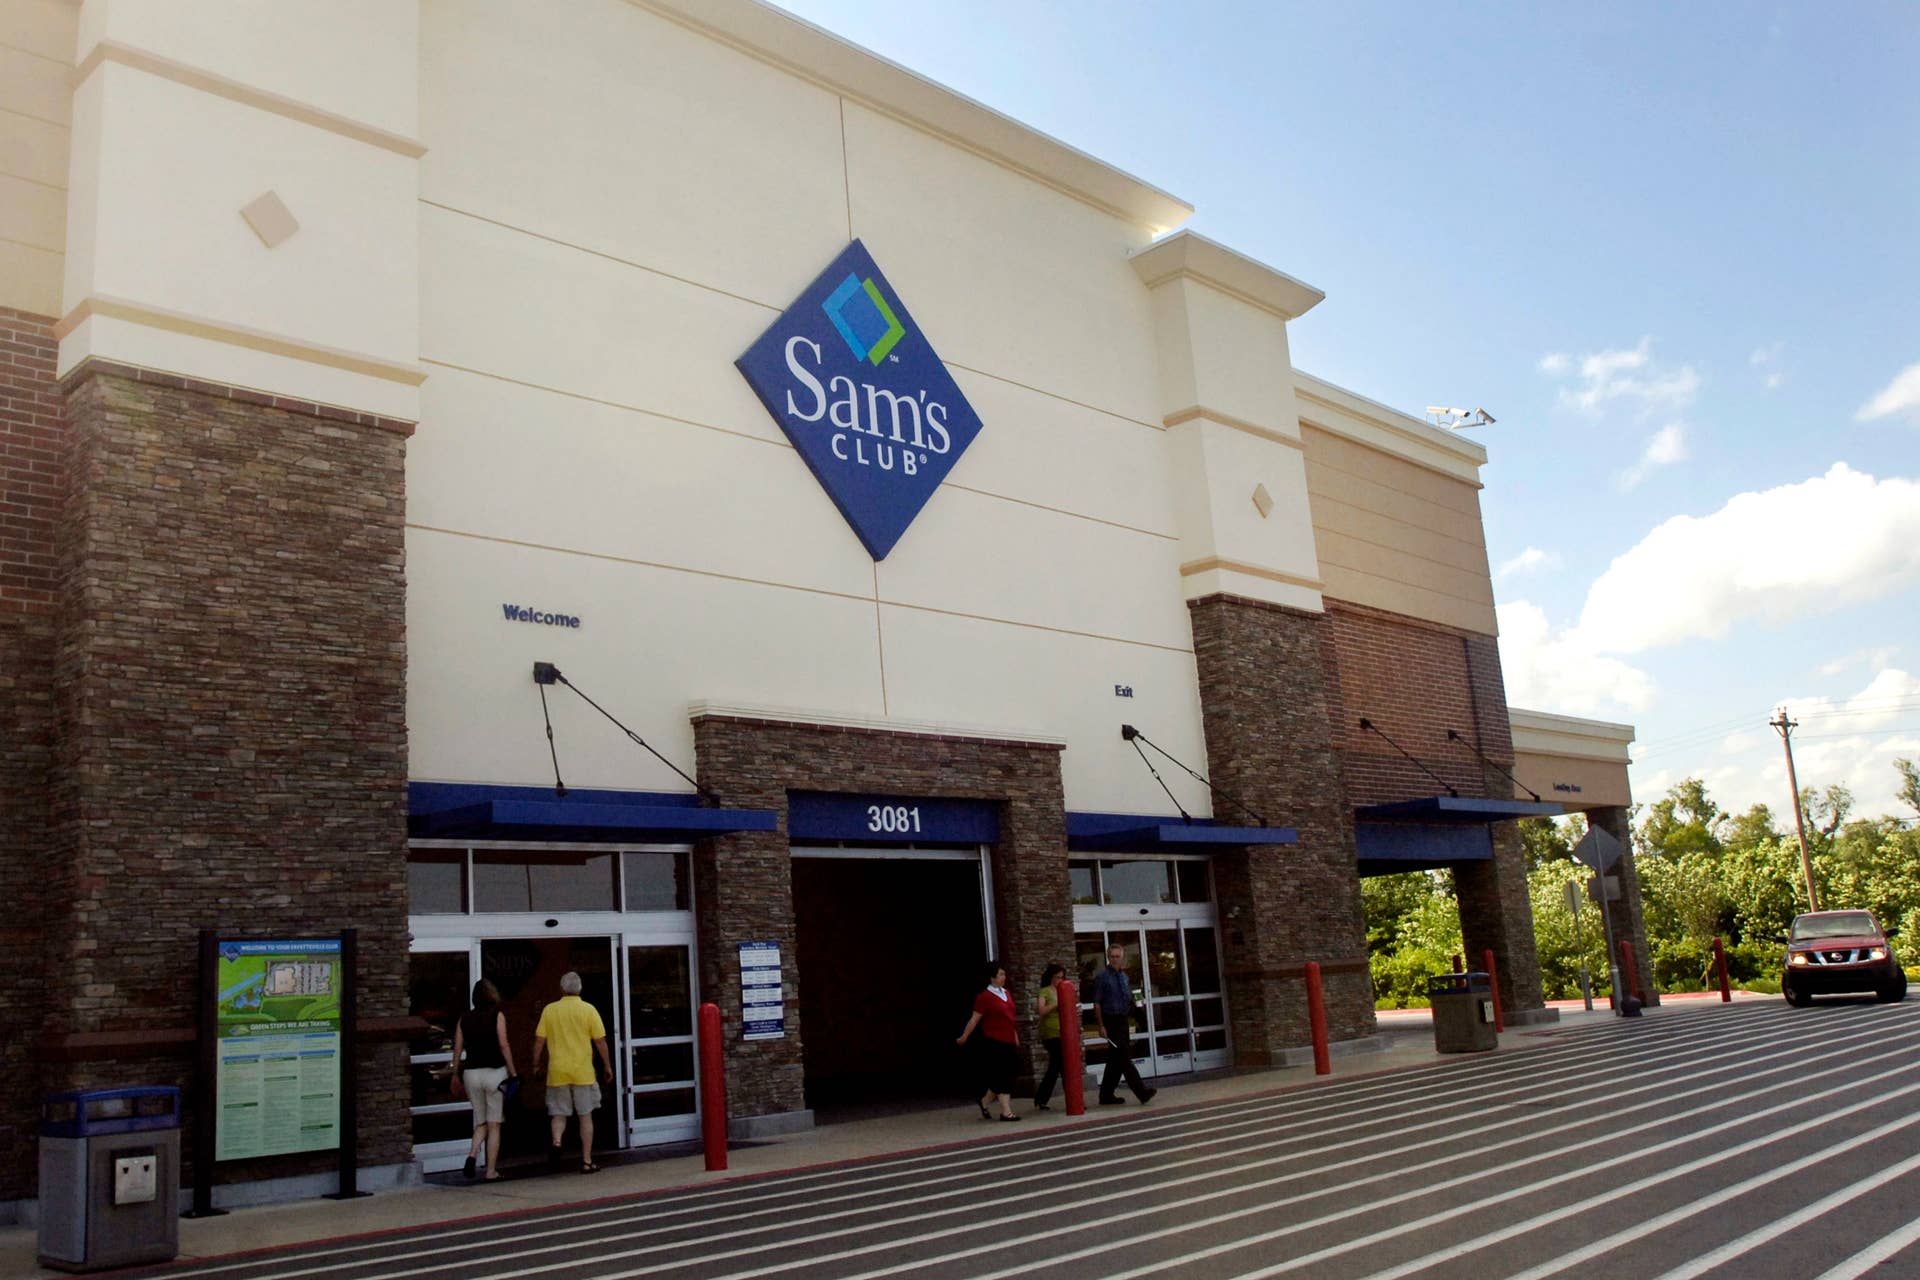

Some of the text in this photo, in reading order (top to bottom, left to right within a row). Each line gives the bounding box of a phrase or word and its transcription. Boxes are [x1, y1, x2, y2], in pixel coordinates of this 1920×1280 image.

[785, 336, 951, 455] Sam's
[502, 603, 581, 628] Welcome
[1114, 684, 1134, 698] Exit
[867, 805, 921, 833] 3081
